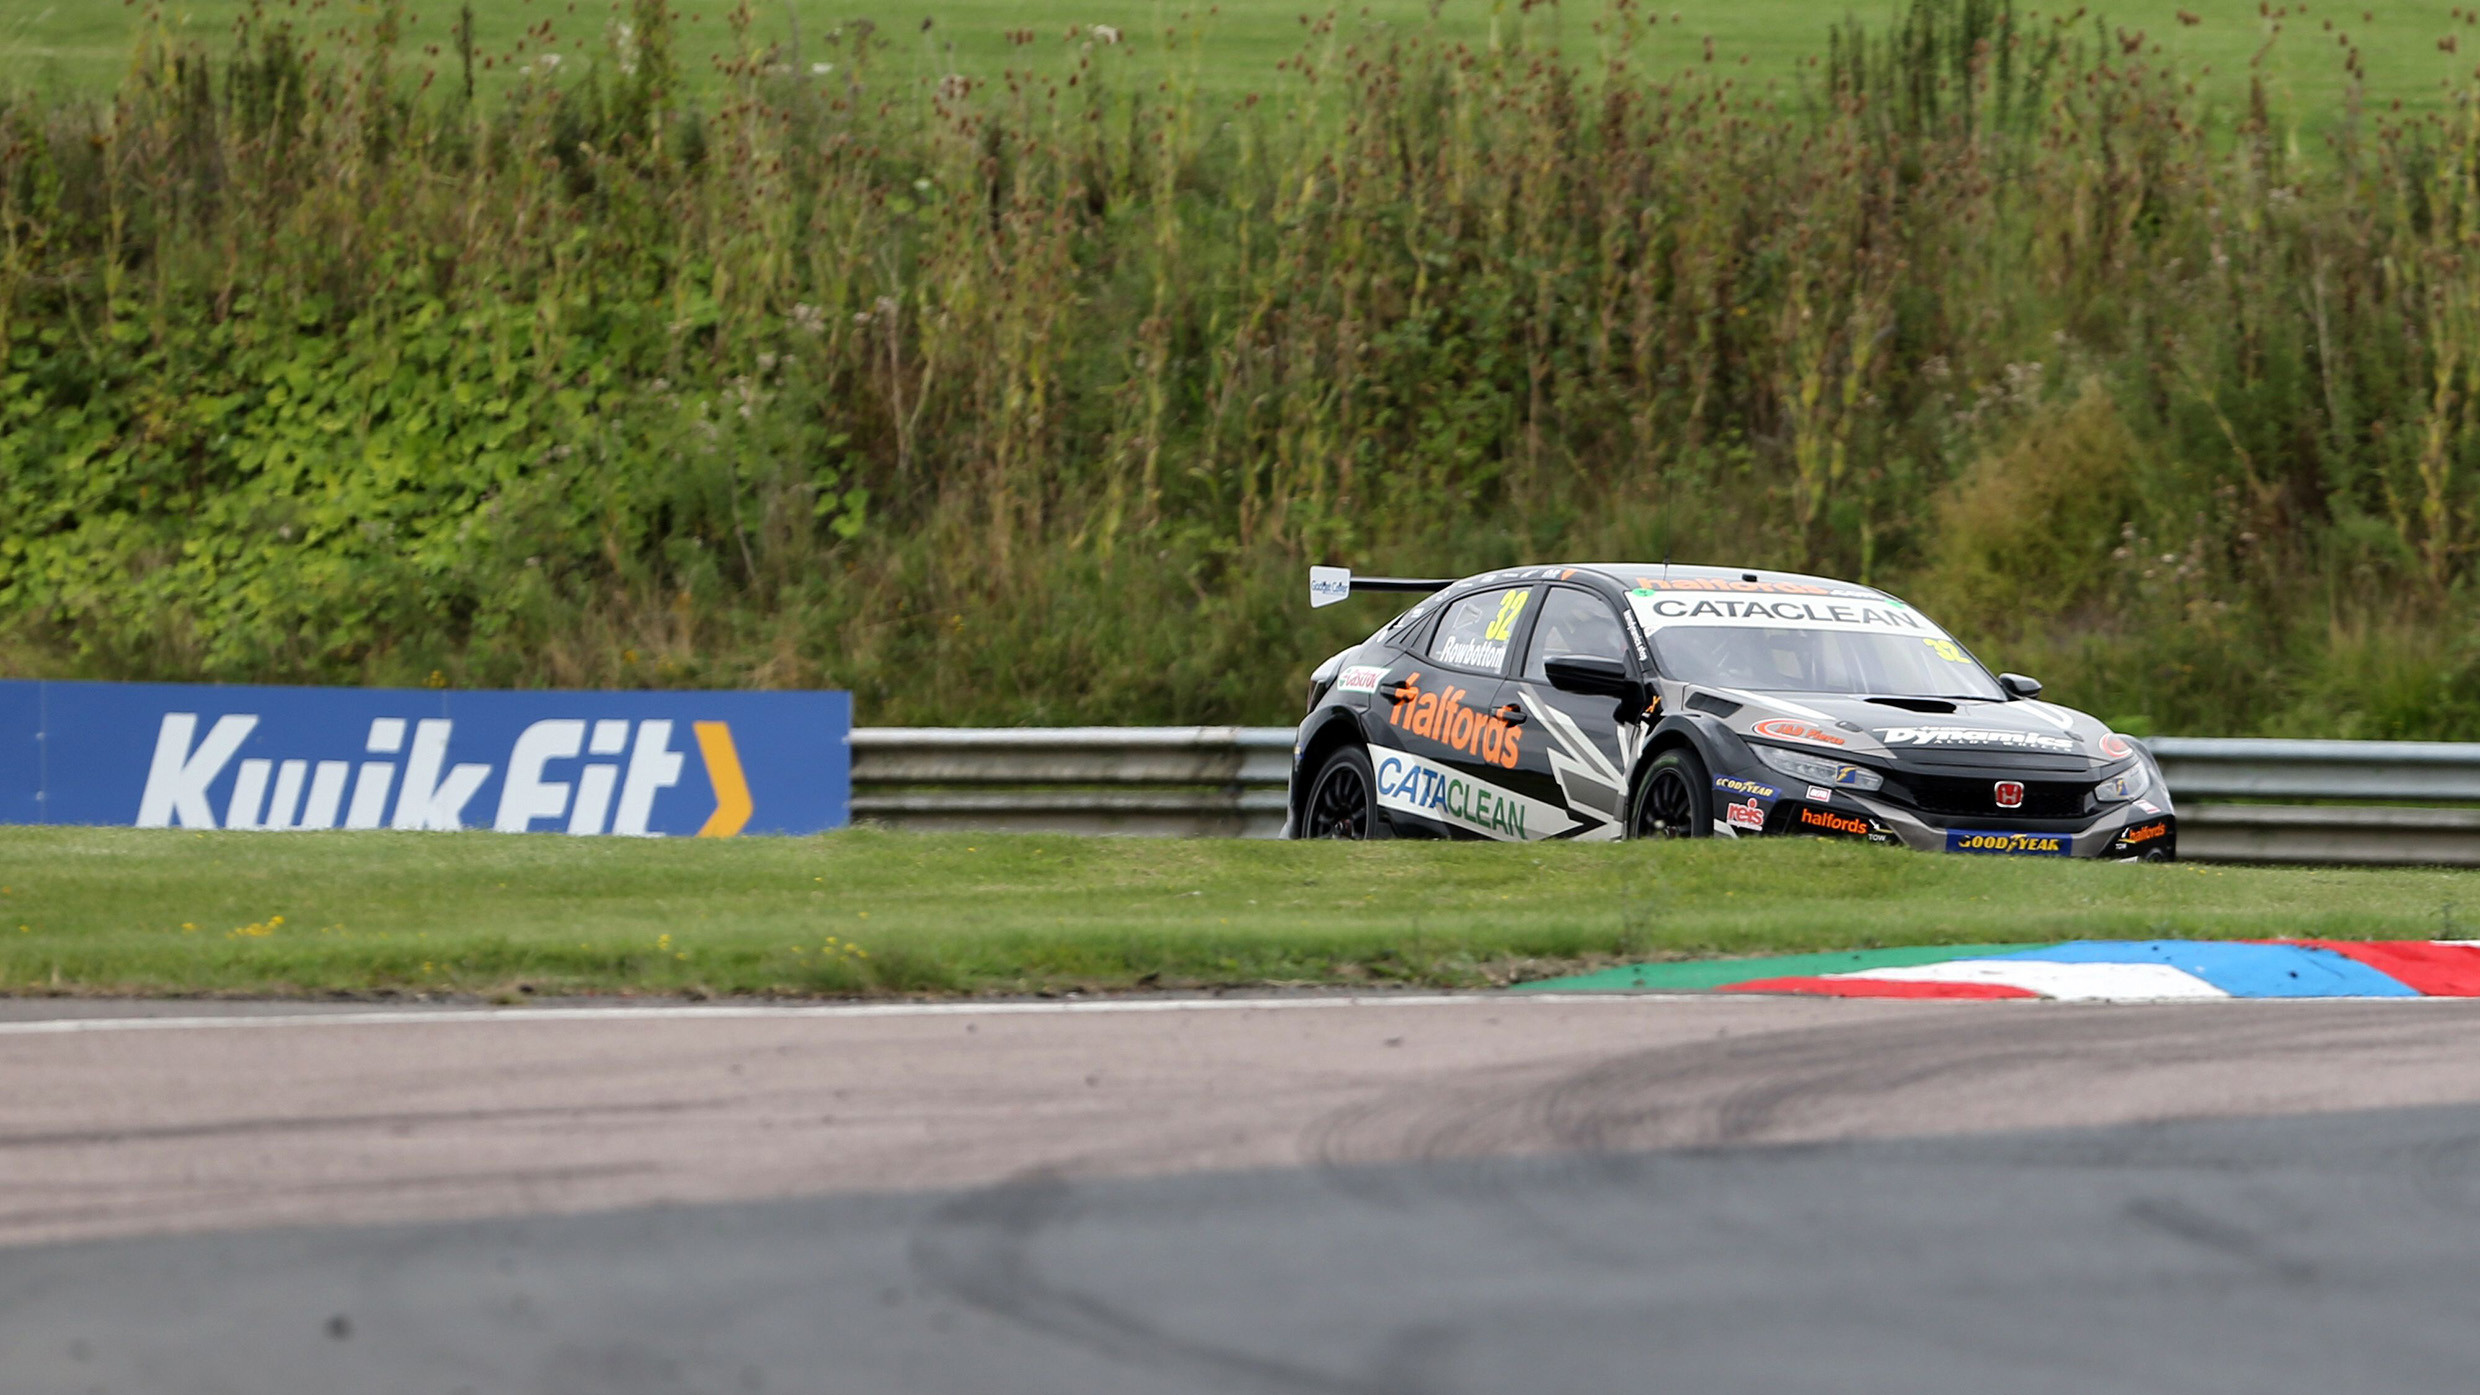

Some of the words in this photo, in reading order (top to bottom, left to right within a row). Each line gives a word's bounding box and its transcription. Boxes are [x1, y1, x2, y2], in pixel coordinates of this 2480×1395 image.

[1636, 577, 1830, 595] halfords
[1485, 589, 1529, 641] 32
[1652, 600, 1920, 629] CATACLEAN
[1440, 636, 1507, 667] Rowbottom
[1922, 638, 1971, 663] 32
[1389, 671, 1523, 769] halfords
[1378, 757, 1528, 840] CATACLEAN
[1715, 777, 1774, 797] GOODYEAR
[1728, 798, 1764, 826] reis
[1801, 808, 1868, 835] halfords
[1867, 833, 1887, 842] TOW
[1958, 833, 2060, 853] GOODYEAR
[2129, 822, 2166, 843] halfords
